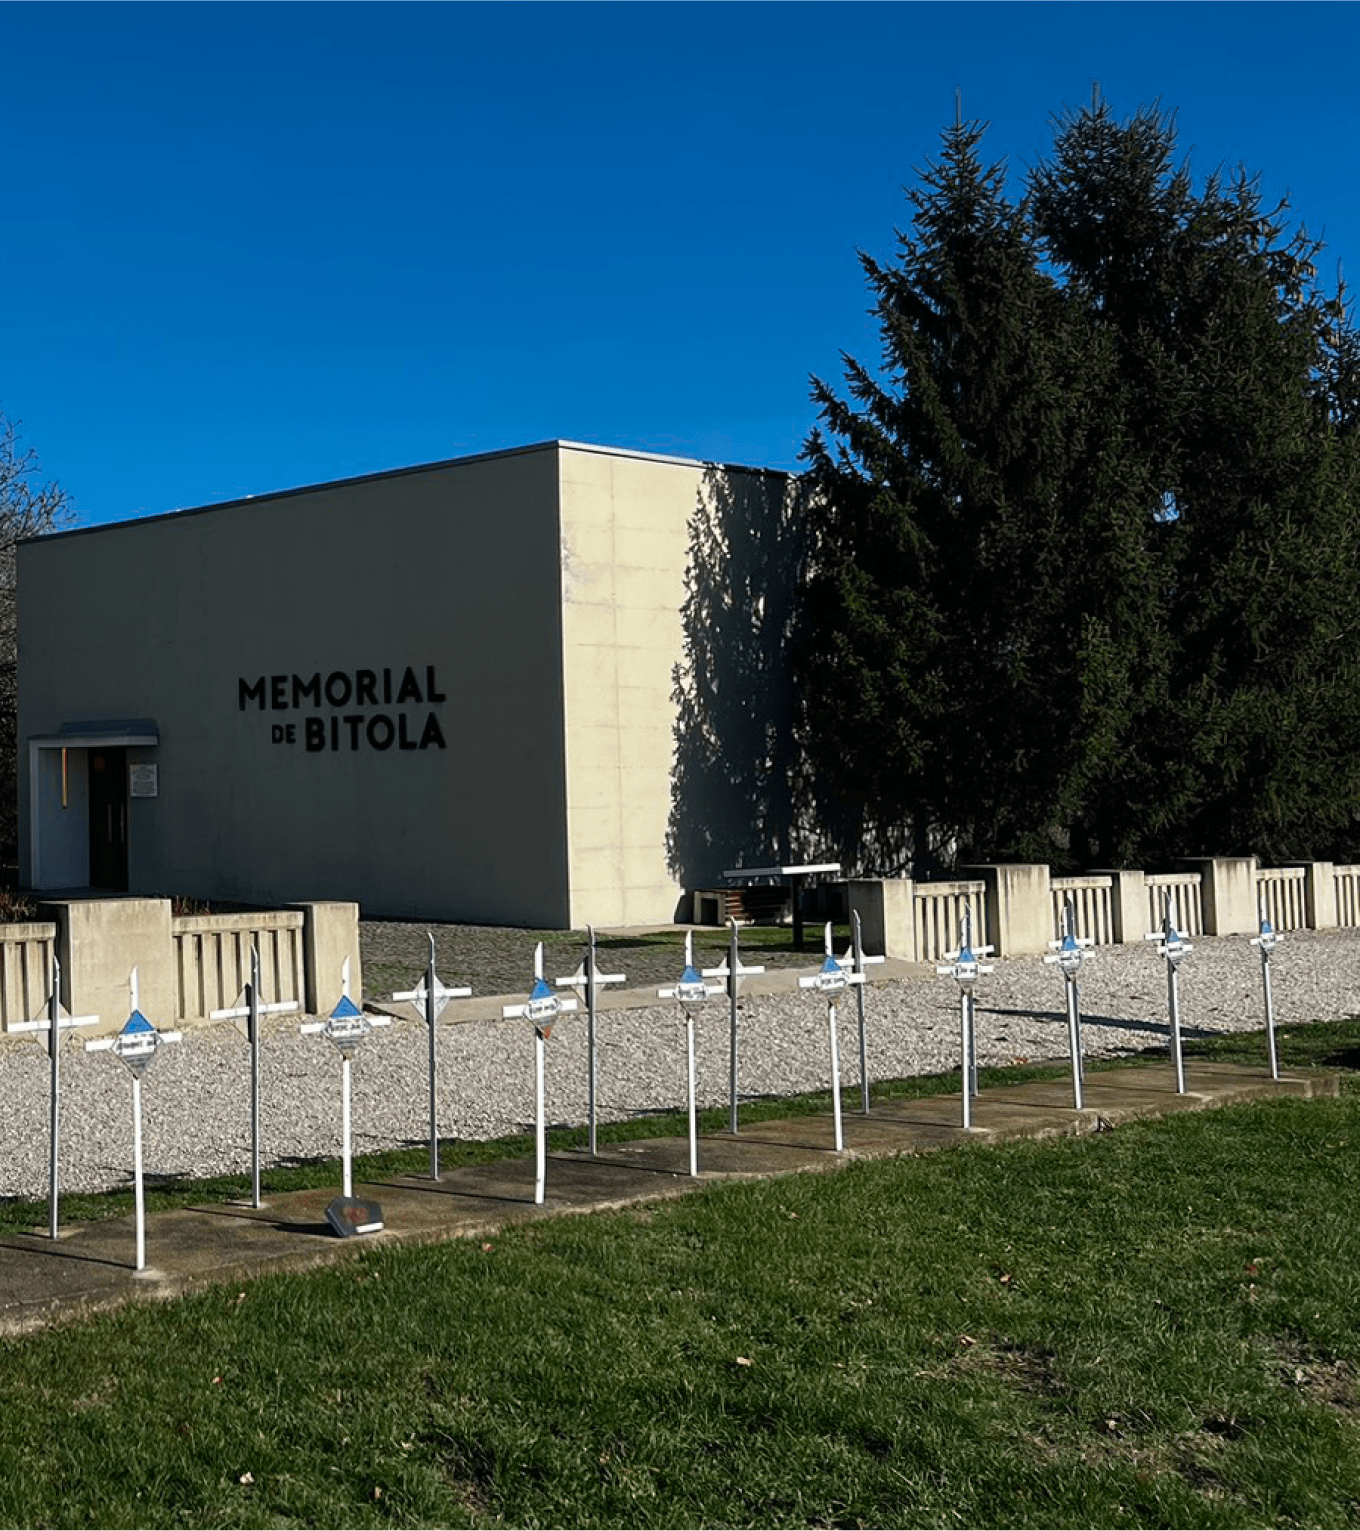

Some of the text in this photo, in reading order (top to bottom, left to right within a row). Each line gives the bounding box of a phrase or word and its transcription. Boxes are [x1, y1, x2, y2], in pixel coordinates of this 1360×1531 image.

[238, 664, 446, 711] MEMORIAL
[271, 712, 447, 752] DE BITOLA
